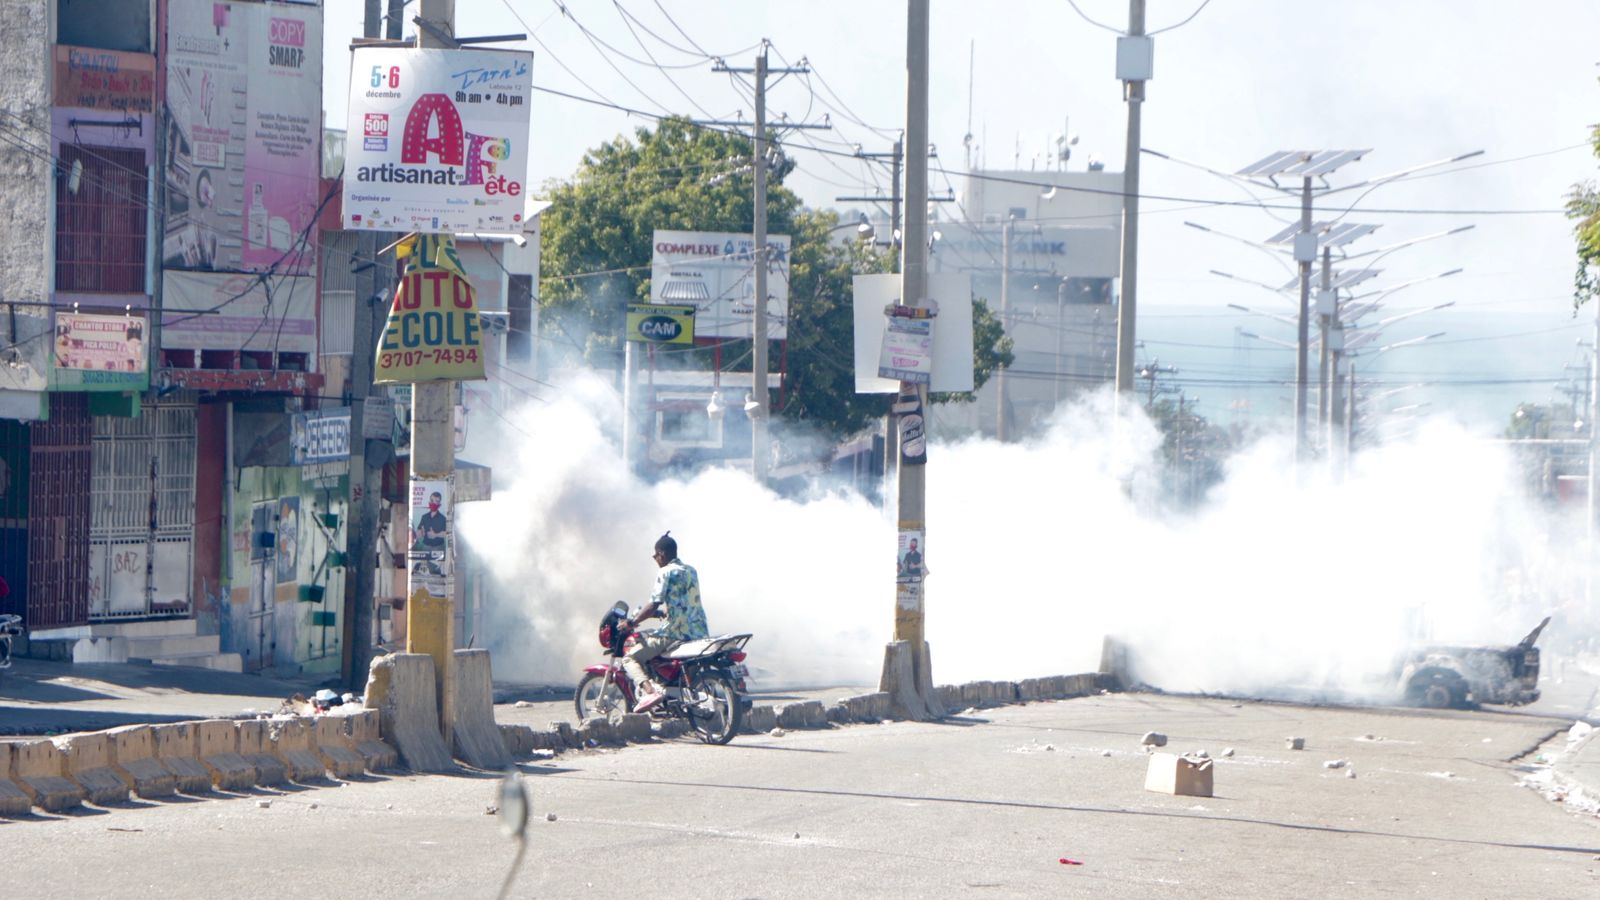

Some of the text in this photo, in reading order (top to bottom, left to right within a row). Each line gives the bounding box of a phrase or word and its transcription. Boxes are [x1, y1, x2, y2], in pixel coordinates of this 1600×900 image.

[271, 20, 304, 43] COPY
[269, 45, 304, 68] SMART
[366, 90, 401, 98] décembre
[468, 93, 482, 103] am
[496, 92, 508, 105] 4h
[509, 95, 523, 107] pm
[365, 119, 387, 133] 500
[357, 162, 456, 185] artisanat
[656, 242, 720, 256] COMPLEXE
[382, 311, 479, 350] ECOLE
[642, 321, 676, 336] CAM
[381, 348, 478, 369] 3707-7494
